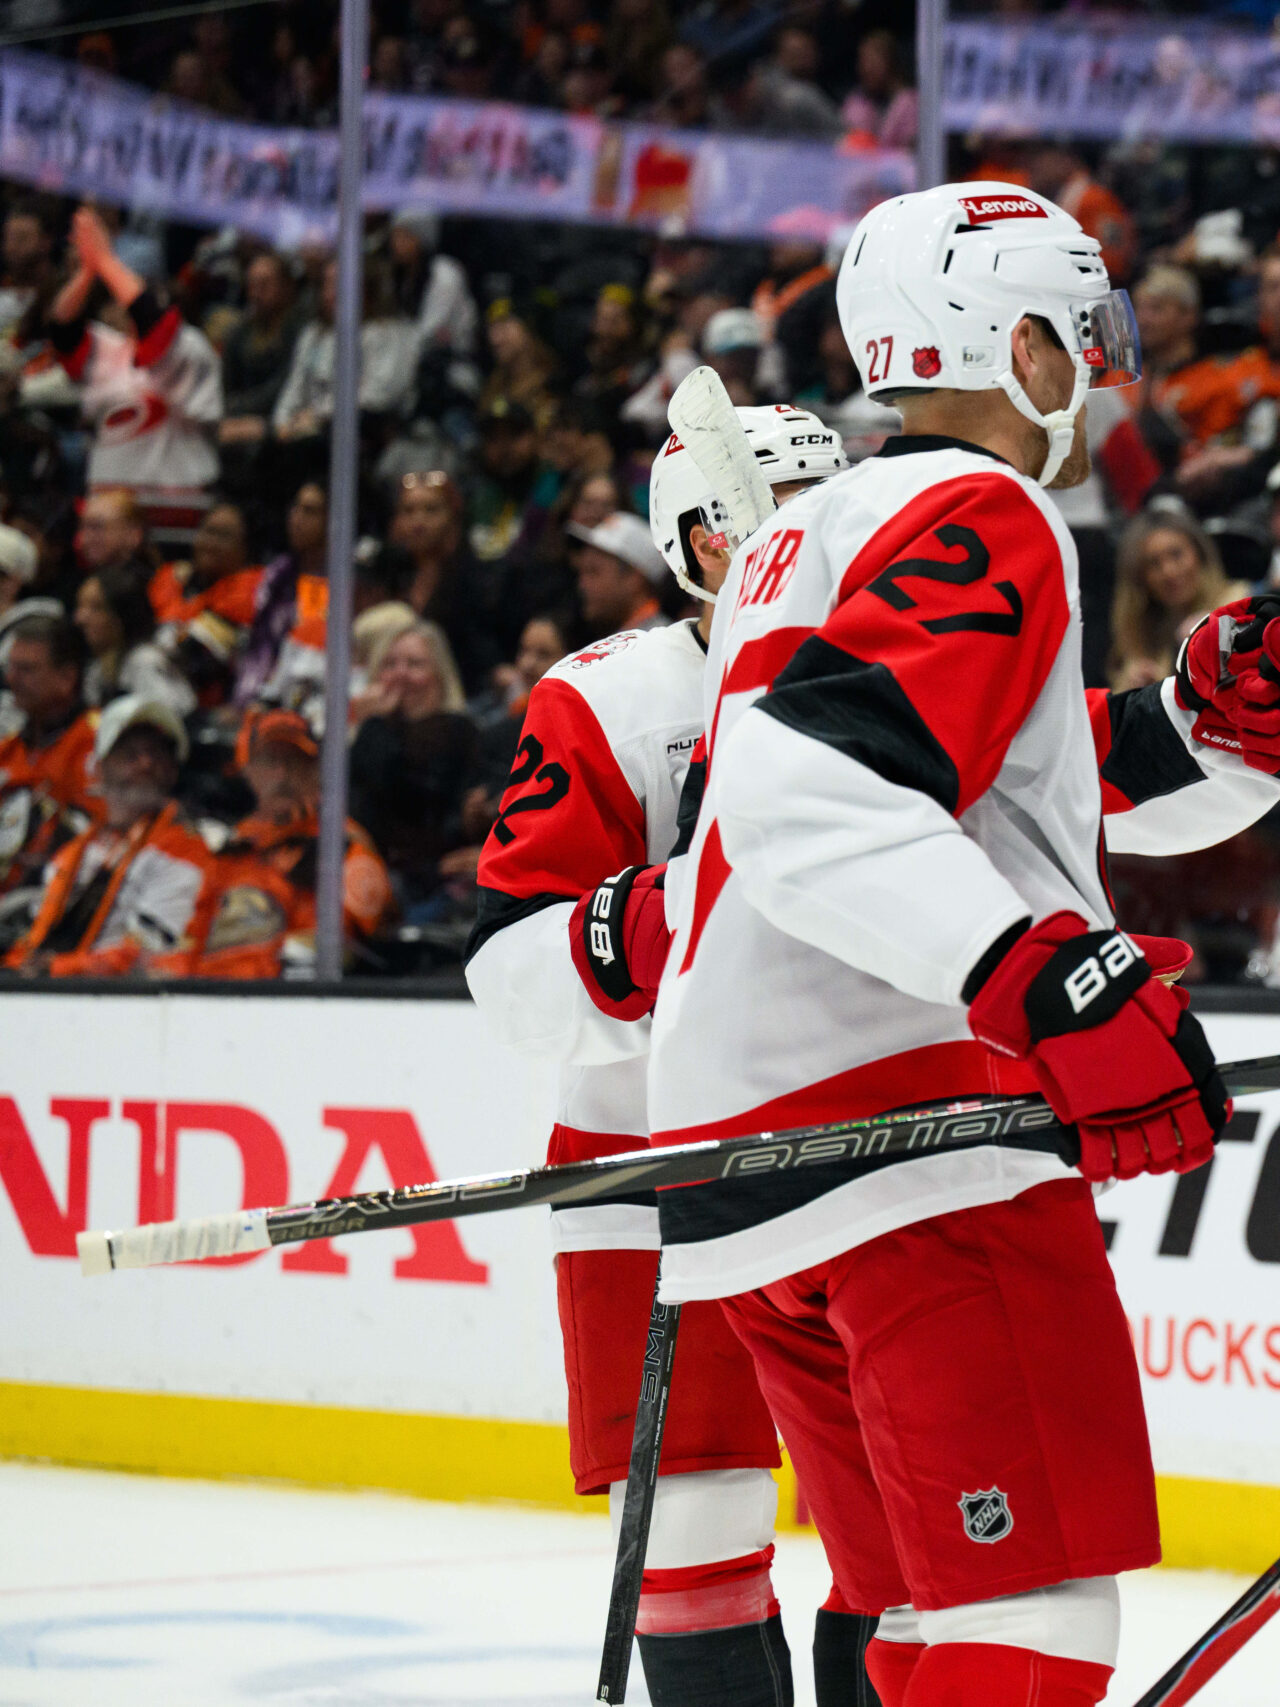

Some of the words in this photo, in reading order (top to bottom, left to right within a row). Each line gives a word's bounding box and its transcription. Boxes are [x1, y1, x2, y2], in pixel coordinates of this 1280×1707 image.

[972, 199, 1038, 216] Lenovo
[866, 336, 893, 384] 27
[790, 434, 833, 446] CCM
[867, 523, 1024, 637] 27
[494, 733, 571, 847] 22
